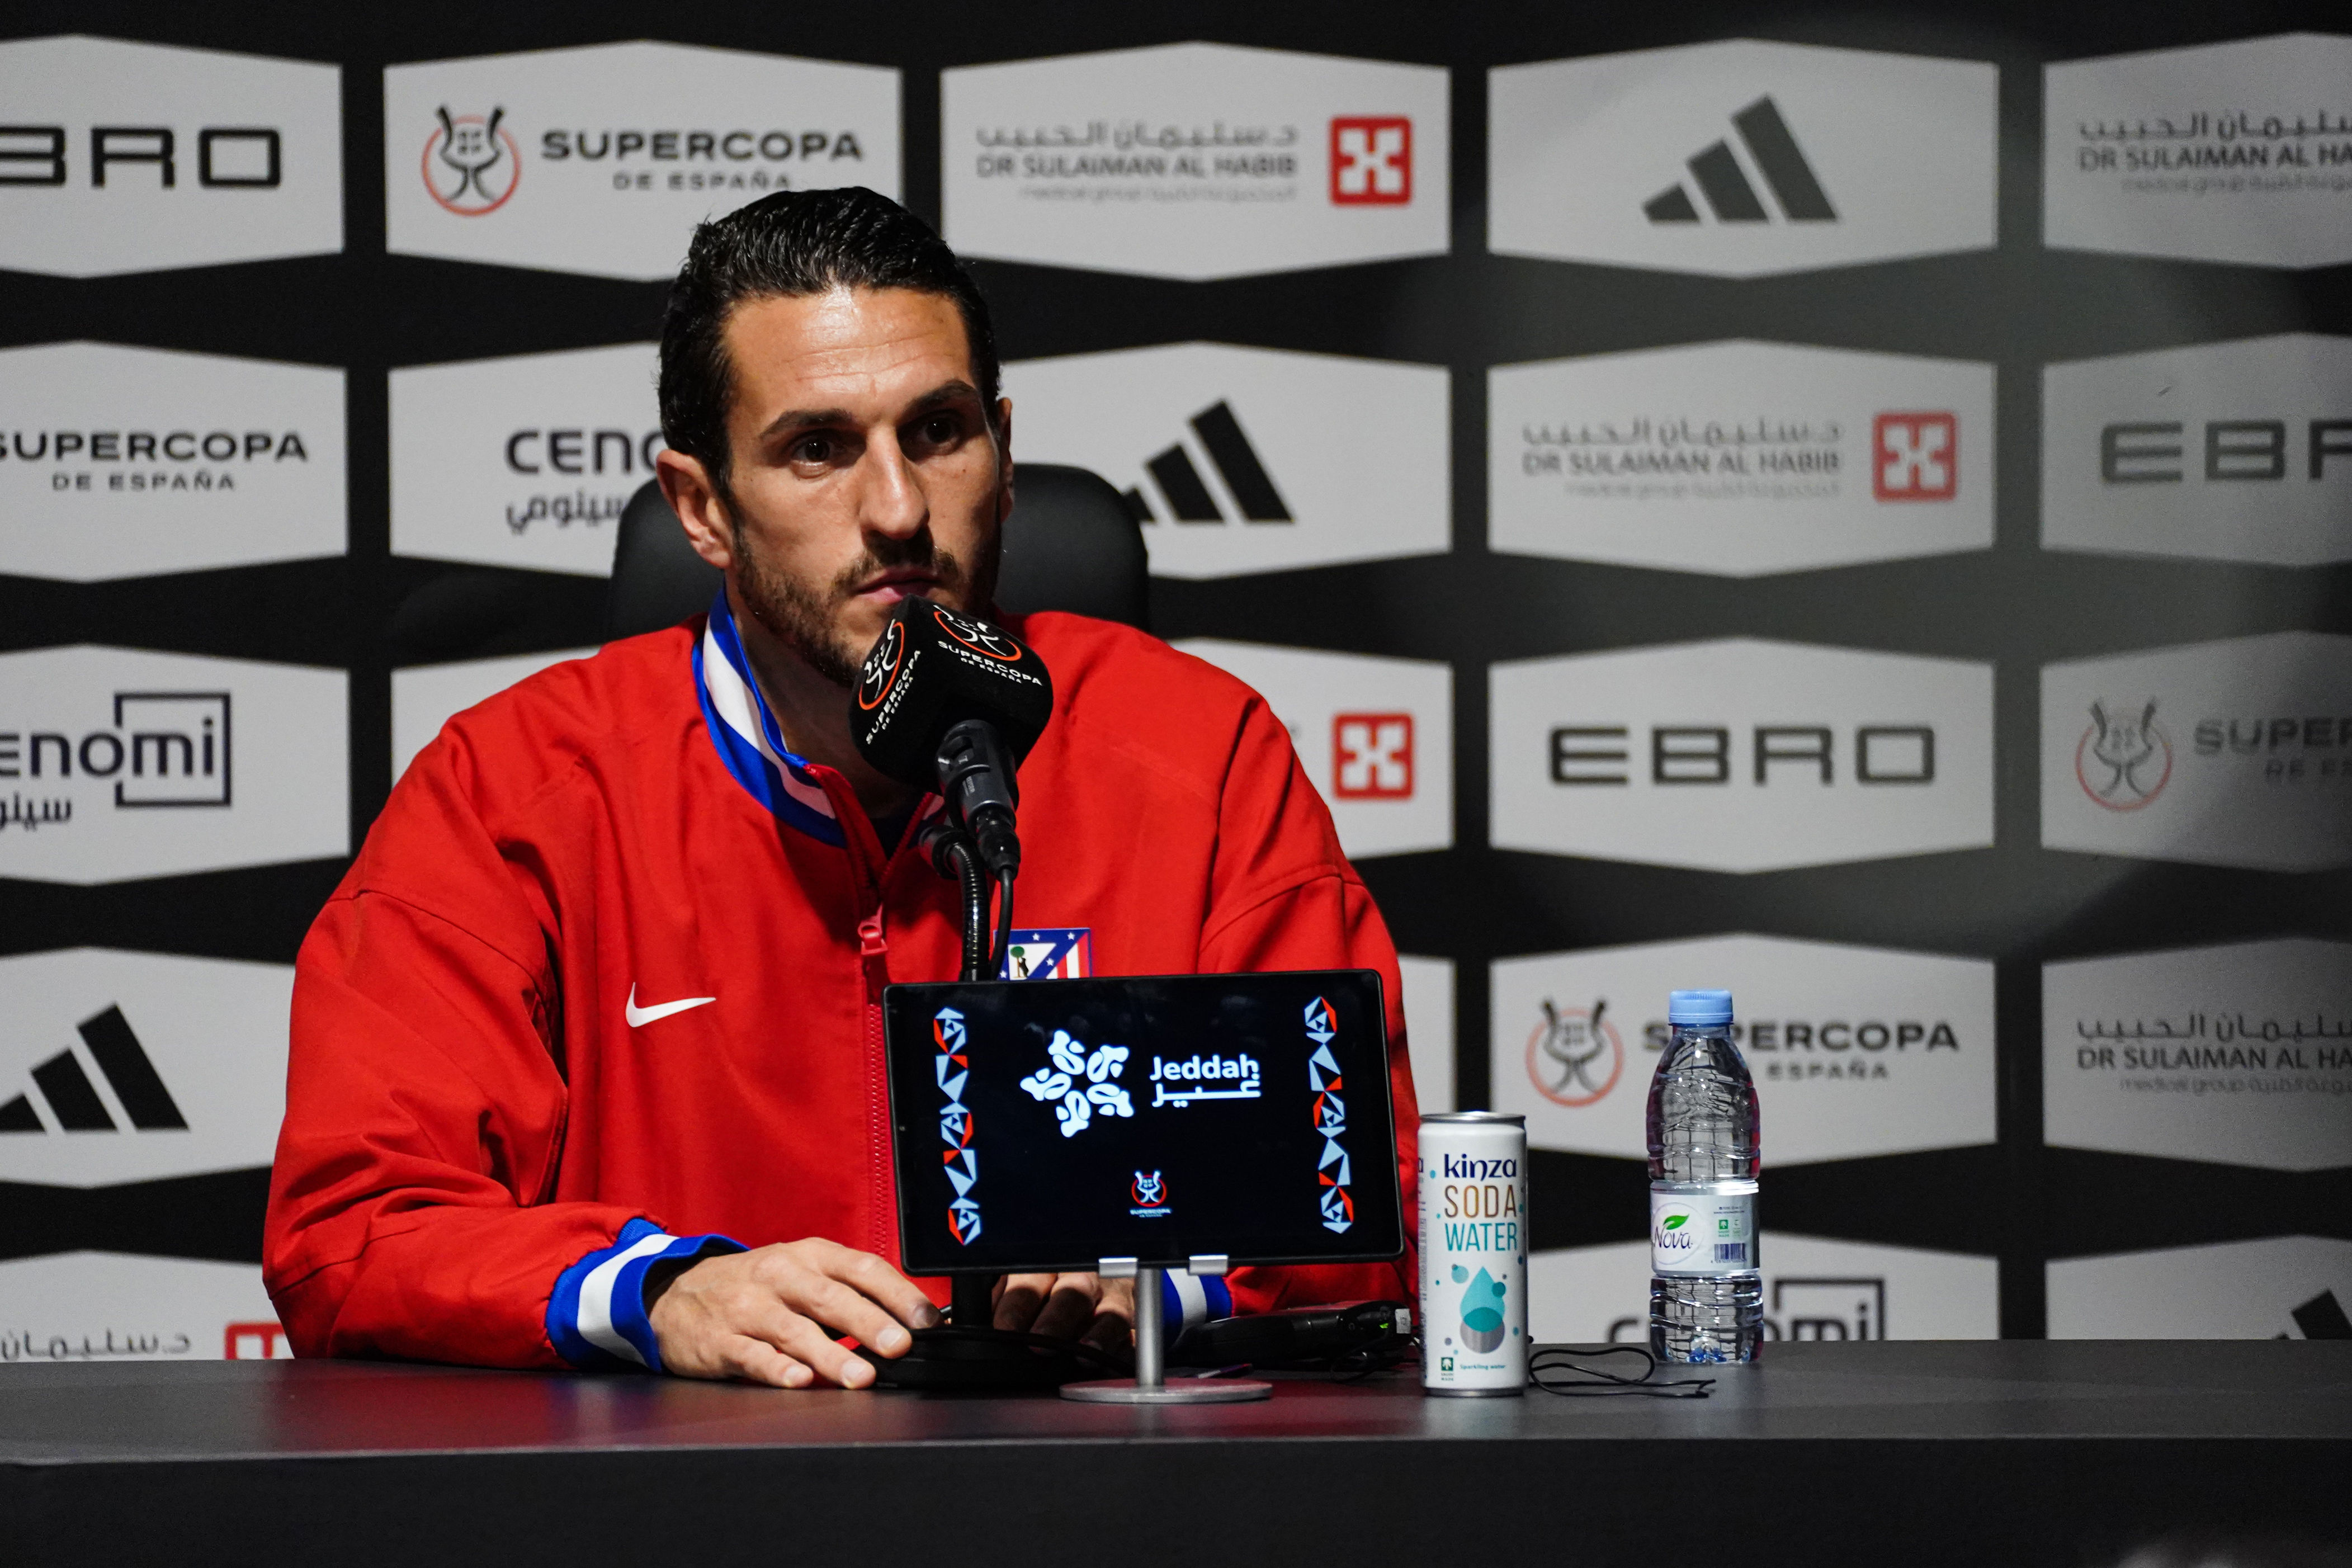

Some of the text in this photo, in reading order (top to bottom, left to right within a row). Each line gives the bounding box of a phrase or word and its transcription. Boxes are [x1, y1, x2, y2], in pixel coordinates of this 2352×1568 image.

[541, 130, 863, 162] SUPERCOPA
[2079, 147, 2117, 171] DR
[2126, 145, 2269, 169] SULAIMAN
[2276, 144, 2310, 167] AL
[976, 154, 1297, 178] DR SULAIMAN AL HABIB
[613, 170, 791, 190] DE ESPAÑA
[0, 432, 308, 462] UPERCOPA
[1522, 451, 1839, 475] DR SULAIMAN AL HABIB
[52, 469, 235, 491] DE ESPAÑA
[938, 641, 1042, 686] SUPERCOPA
[961, 657, 974, 665] DE
[866, 650, 920, 744] SUPERCOPA
[1548, 725, 1935, 786] EBRO
[1149, 1054, 1259, 1080] Jeddah
[1765, 1059, 1888, 1080] ESPAÑA
[2076, 1047, 2115, 1070] DR
[2123, 1046, 2267, 1070] SULAIMAN
[2275, 1046, 2309, 1070] AL
[1444, 1154, 1517, 1181] kinza
[1444, 1184, 1517, 1218] SODA
[1445, 1222, 1517, 1252] WATER
[1654, 1225, 1690, 1249] Nova
